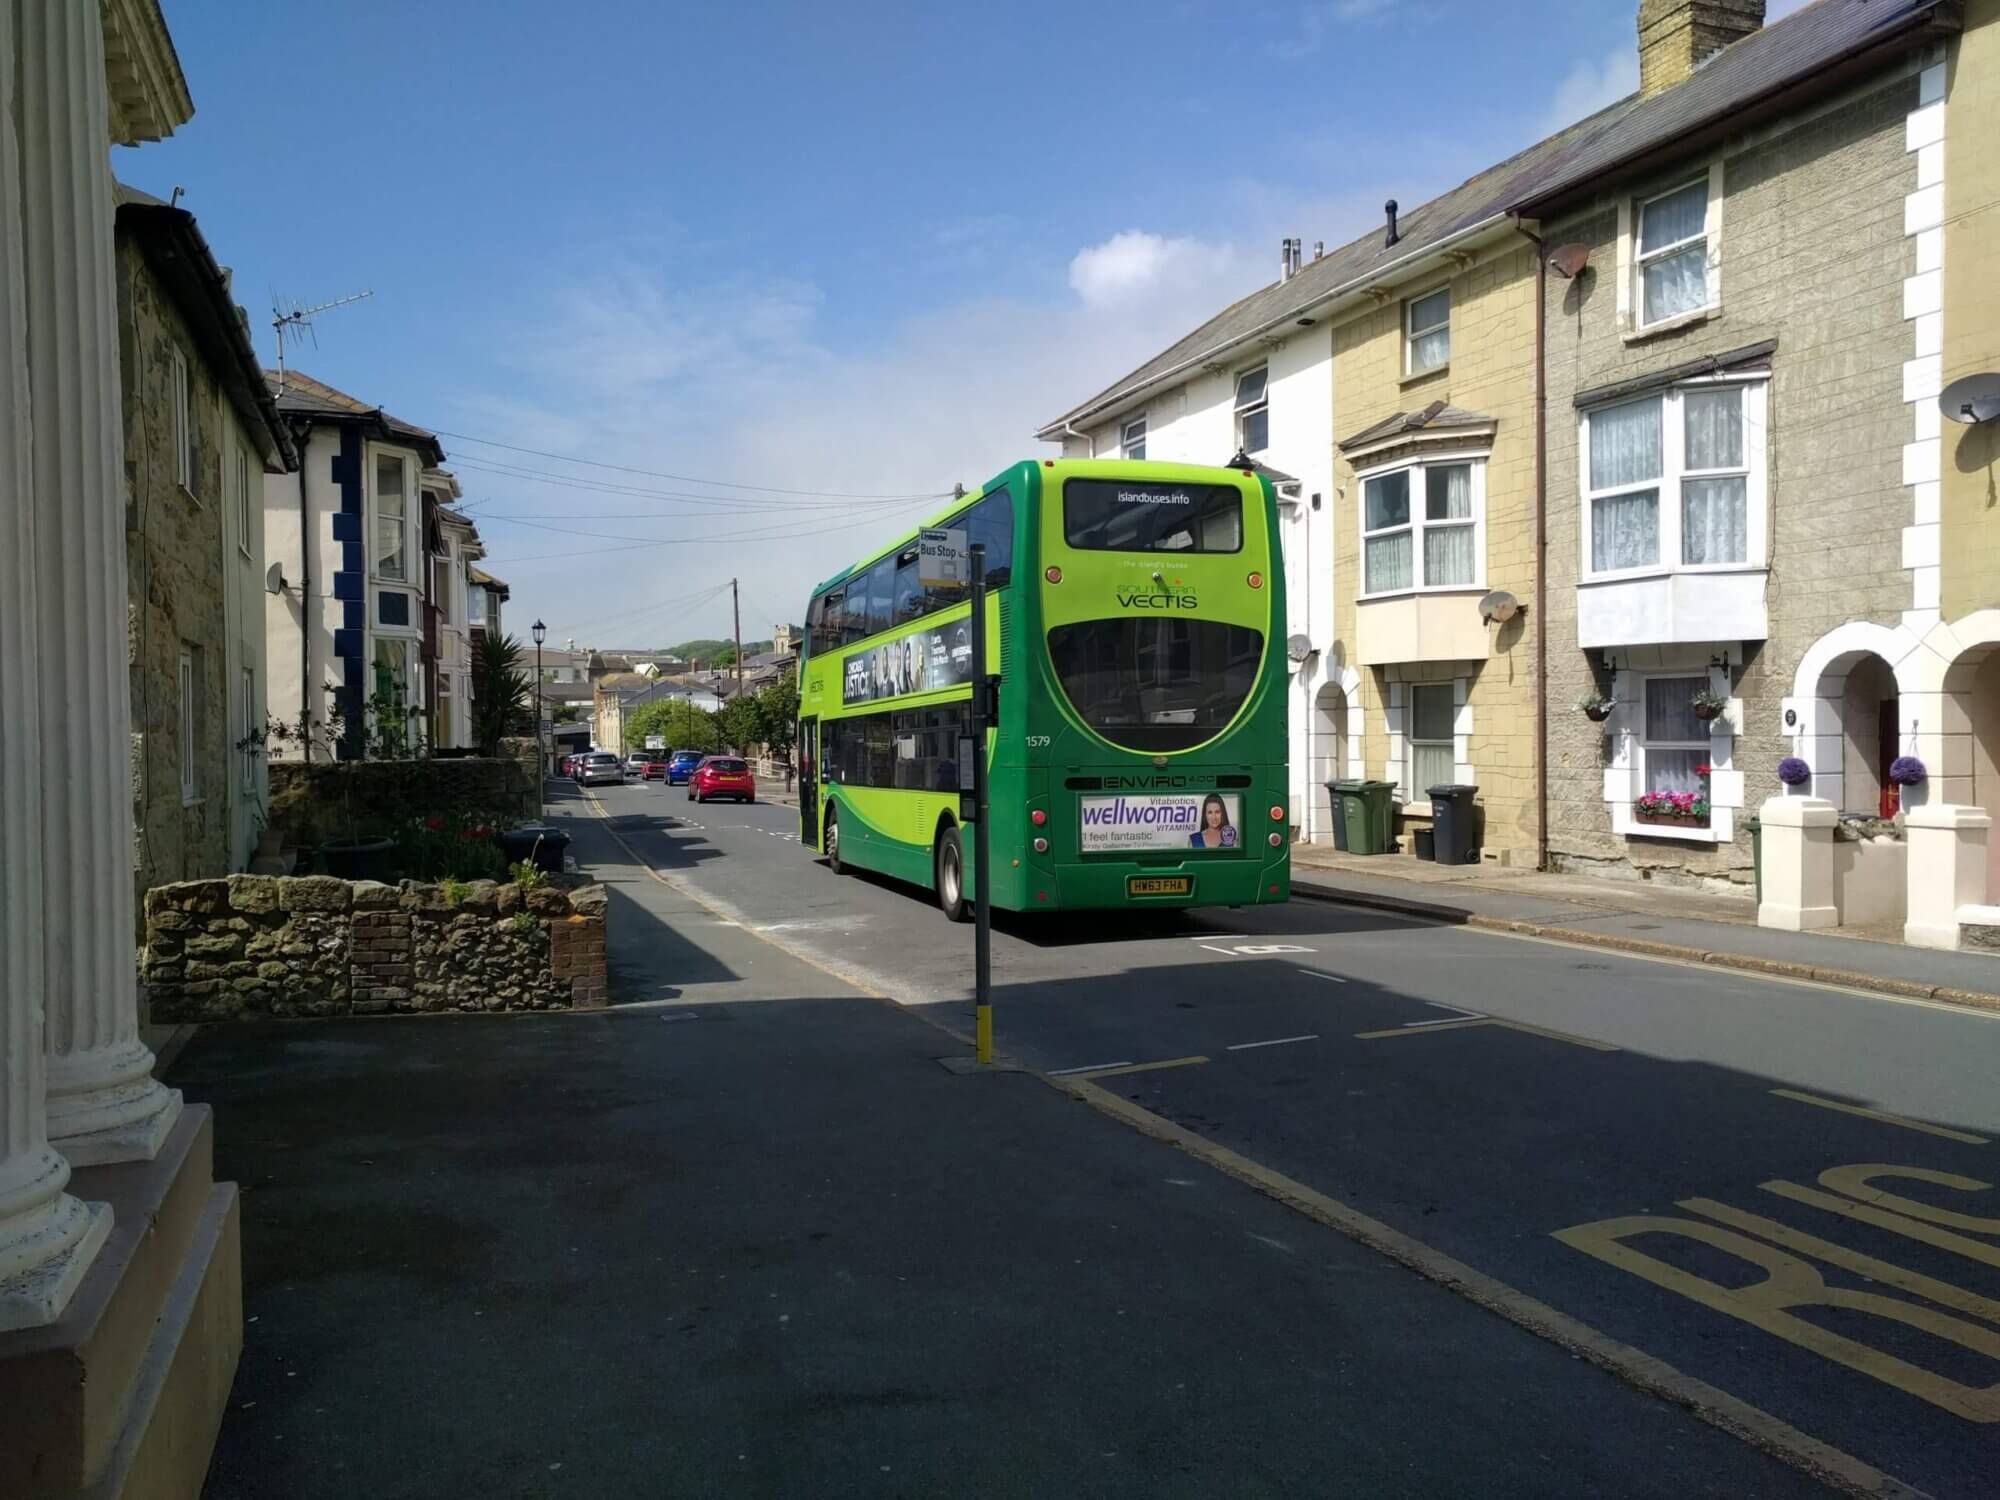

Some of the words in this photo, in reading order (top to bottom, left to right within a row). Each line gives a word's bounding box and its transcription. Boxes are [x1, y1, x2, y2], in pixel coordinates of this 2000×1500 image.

[1118, 491, 1190, 505] islandbuses.info
[921, 544, 936, 556] Bus
[937, 545, 957, 560] Stop
[1116, 594, 1198, 609] VECTIS
[1025, 736, 1050, 747] 1579
[1103, 776, 1186, 788] ENVIRO
[1083, 798, 1197, 825] wellwoman
[1156, 824, 1196, 832] VITAMINS
[1089, 832, 1109, 841] feel
[1134, 880, 1161, 892] HW63
[1163, 879, 1183, 891] FHA
